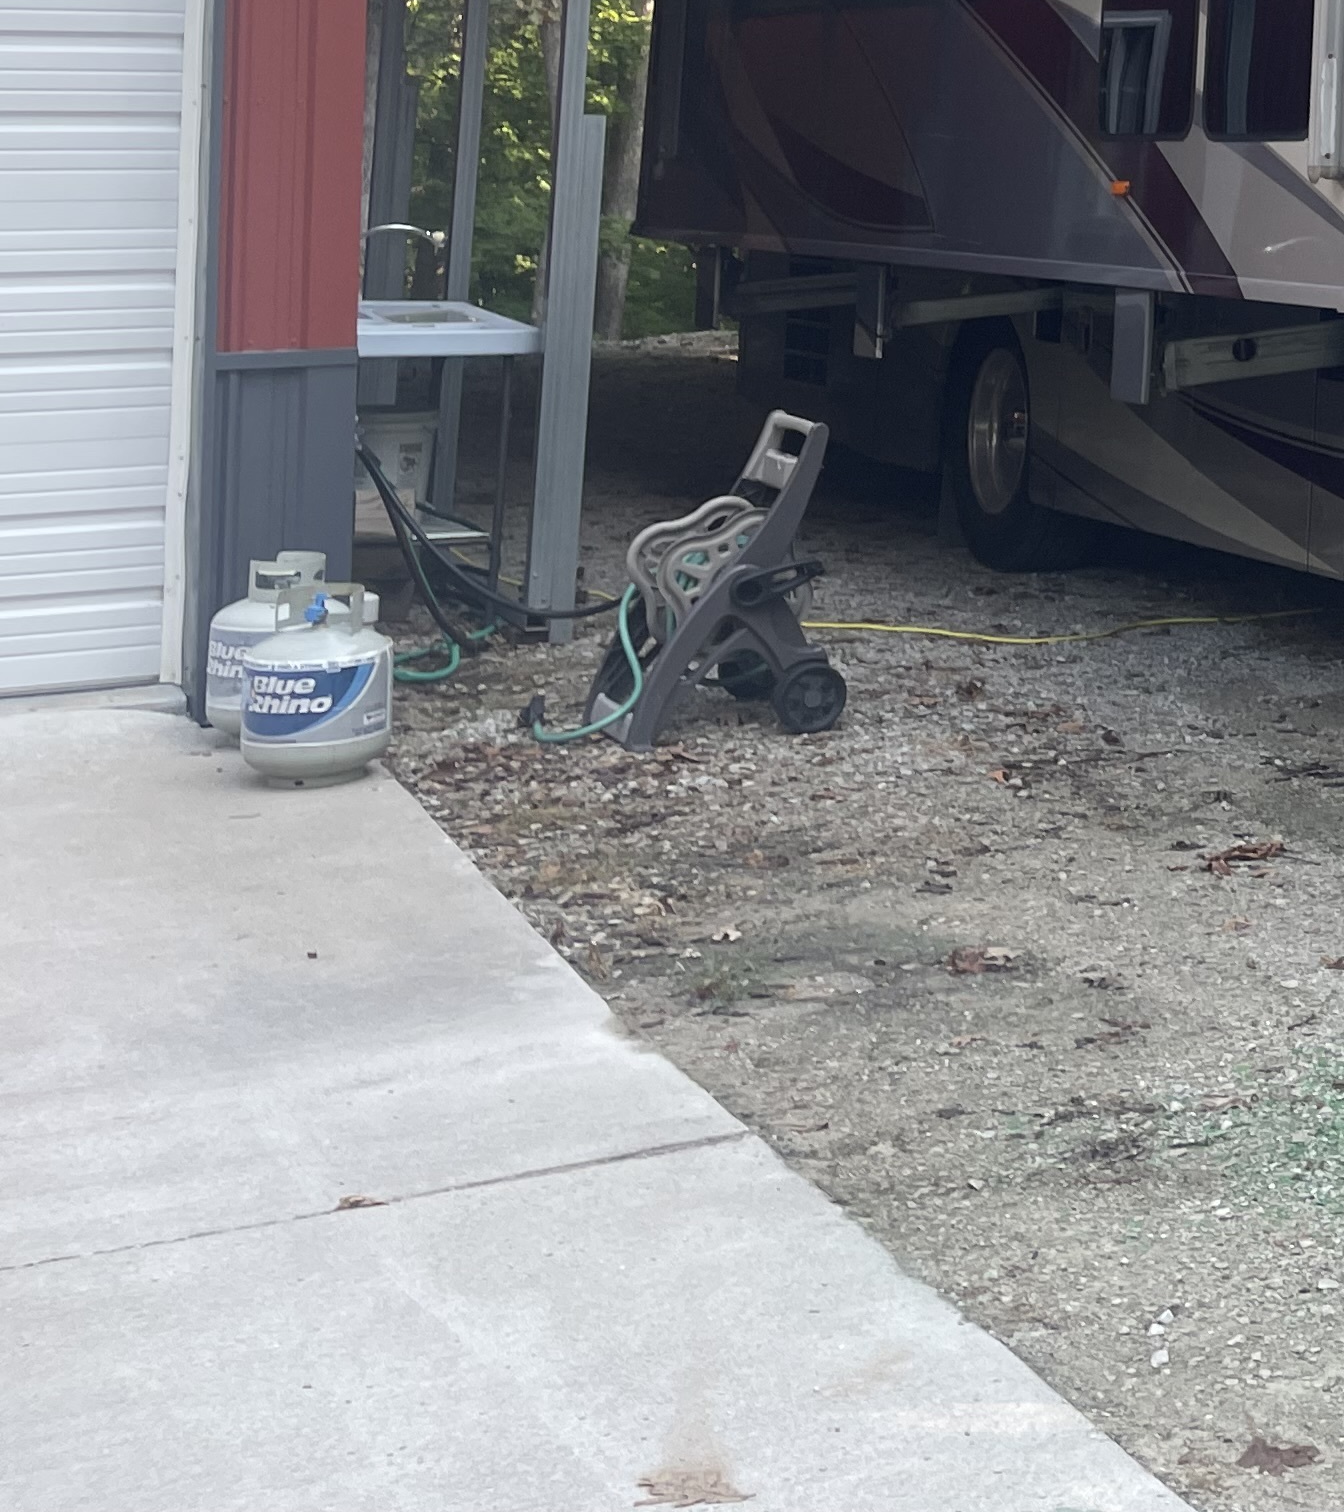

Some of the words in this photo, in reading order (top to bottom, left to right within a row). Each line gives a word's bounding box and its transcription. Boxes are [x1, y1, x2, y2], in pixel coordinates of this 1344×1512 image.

[206, 656, 243, 679] Rhin
[253, 675, 317, 695] Blue
[248, 690, 334, 715] Rhino
